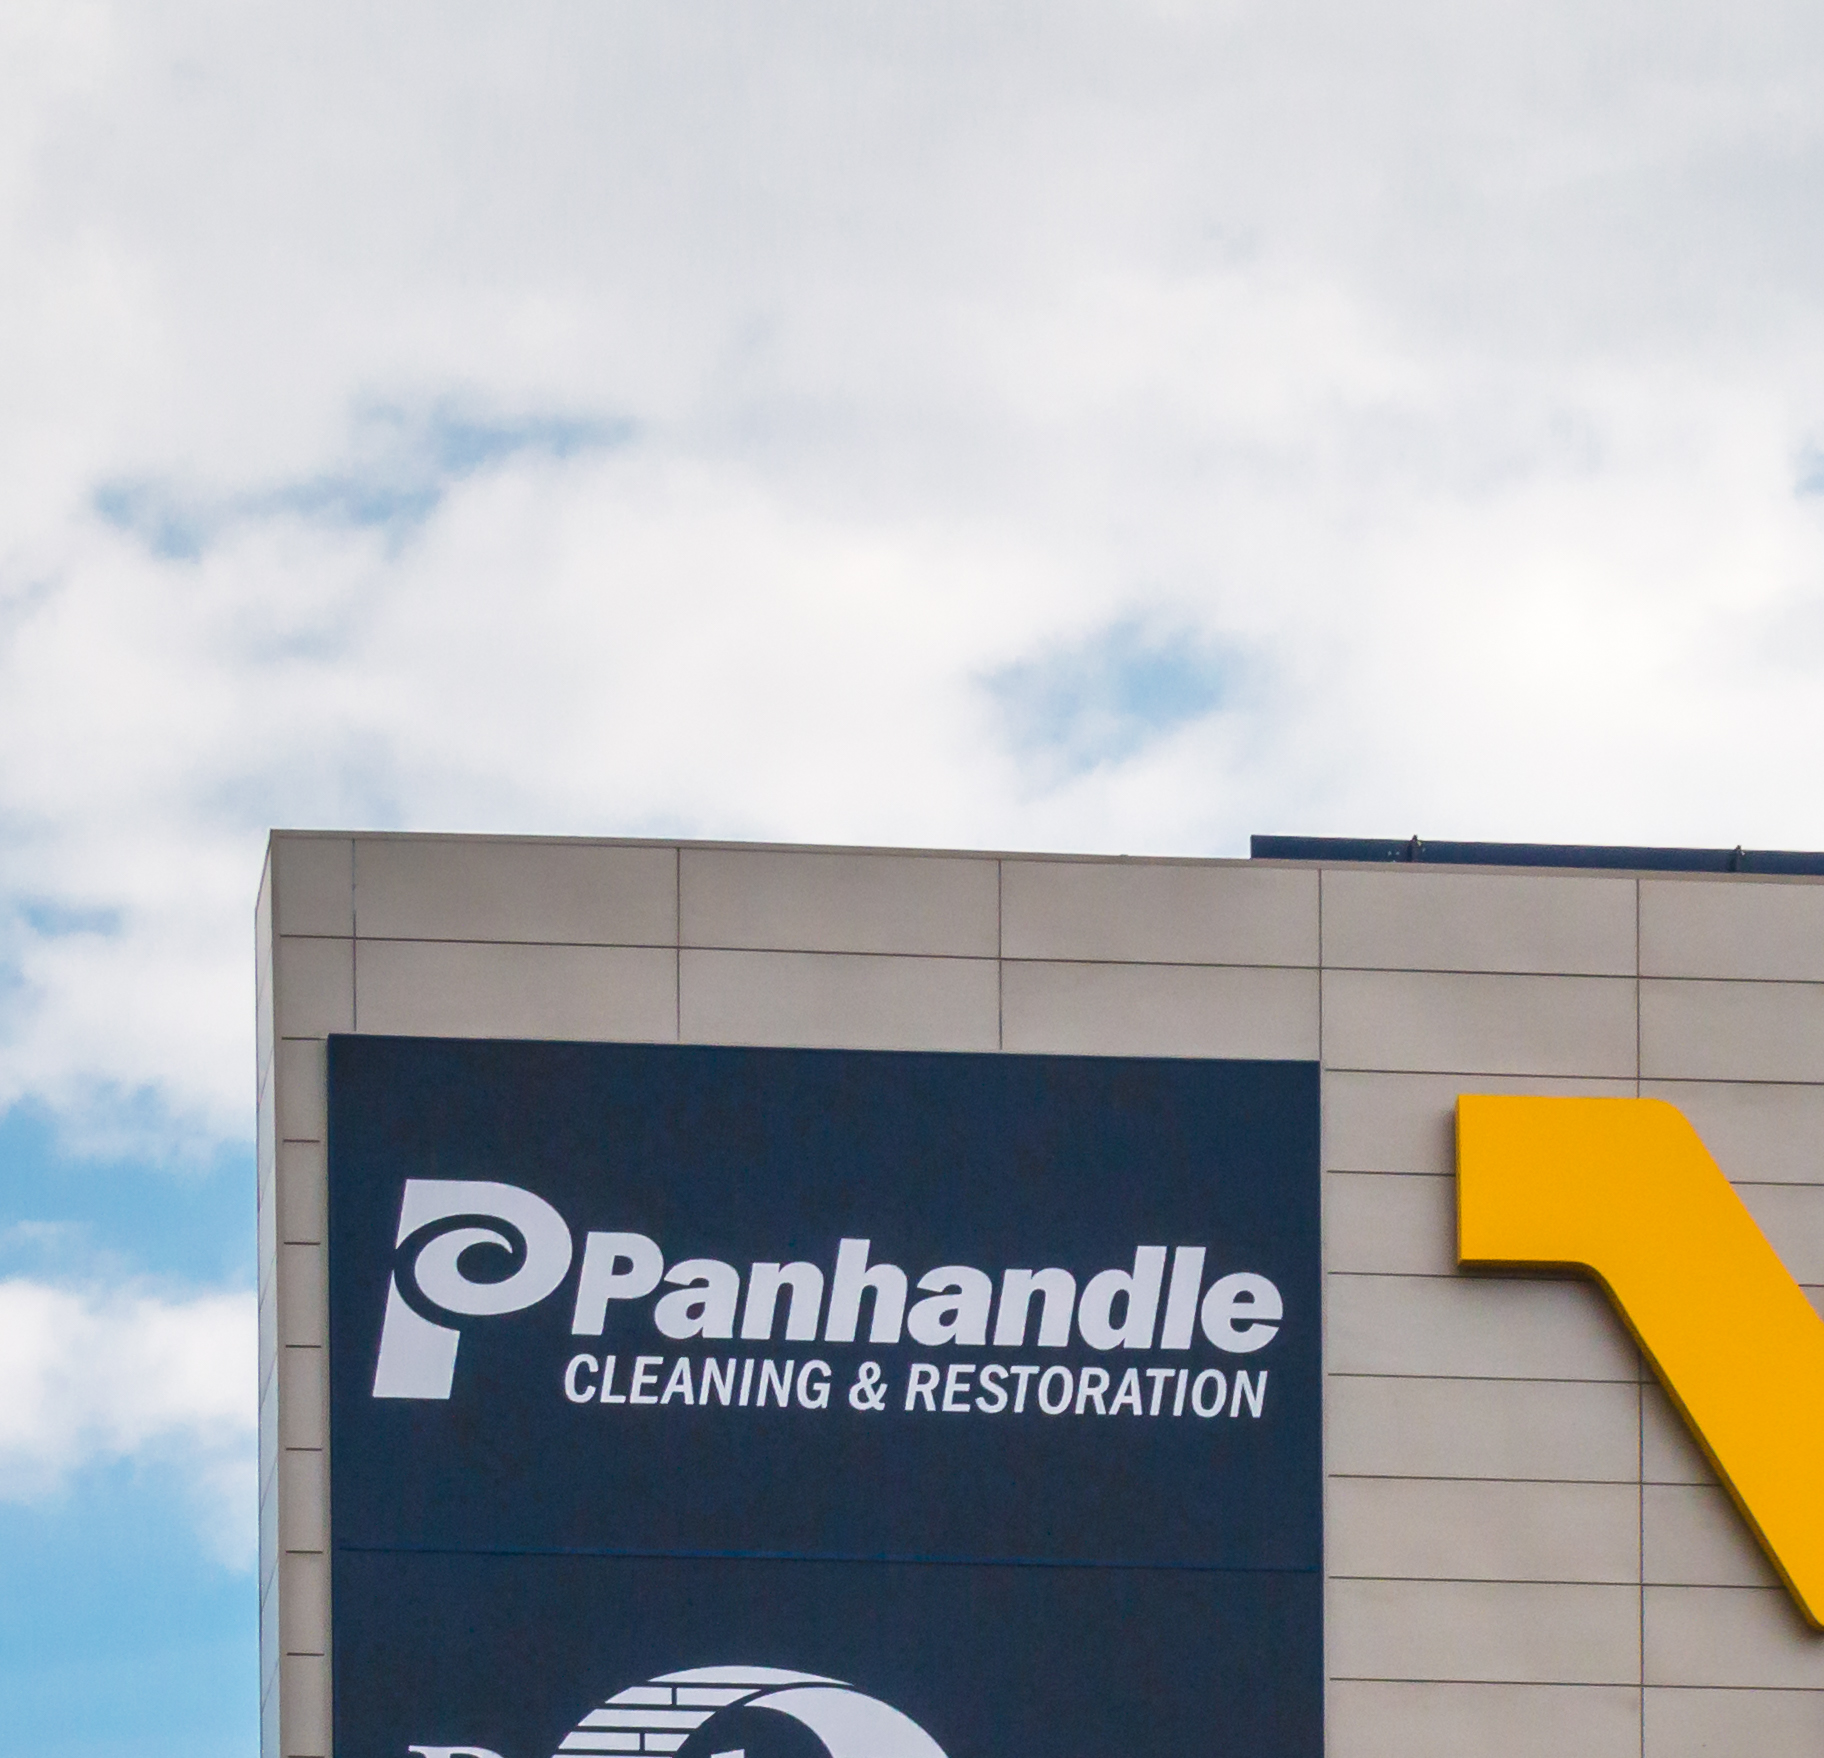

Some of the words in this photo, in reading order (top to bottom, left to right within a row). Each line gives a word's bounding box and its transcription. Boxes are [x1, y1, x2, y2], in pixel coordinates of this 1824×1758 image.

[570, 1230, 1284, 1354] Panhandle
[564, 1353, 832, 1410] CLEANING
[848, 1361, 888, 1411] &
[904, 1363, 1268, 1418] RESTORATION
